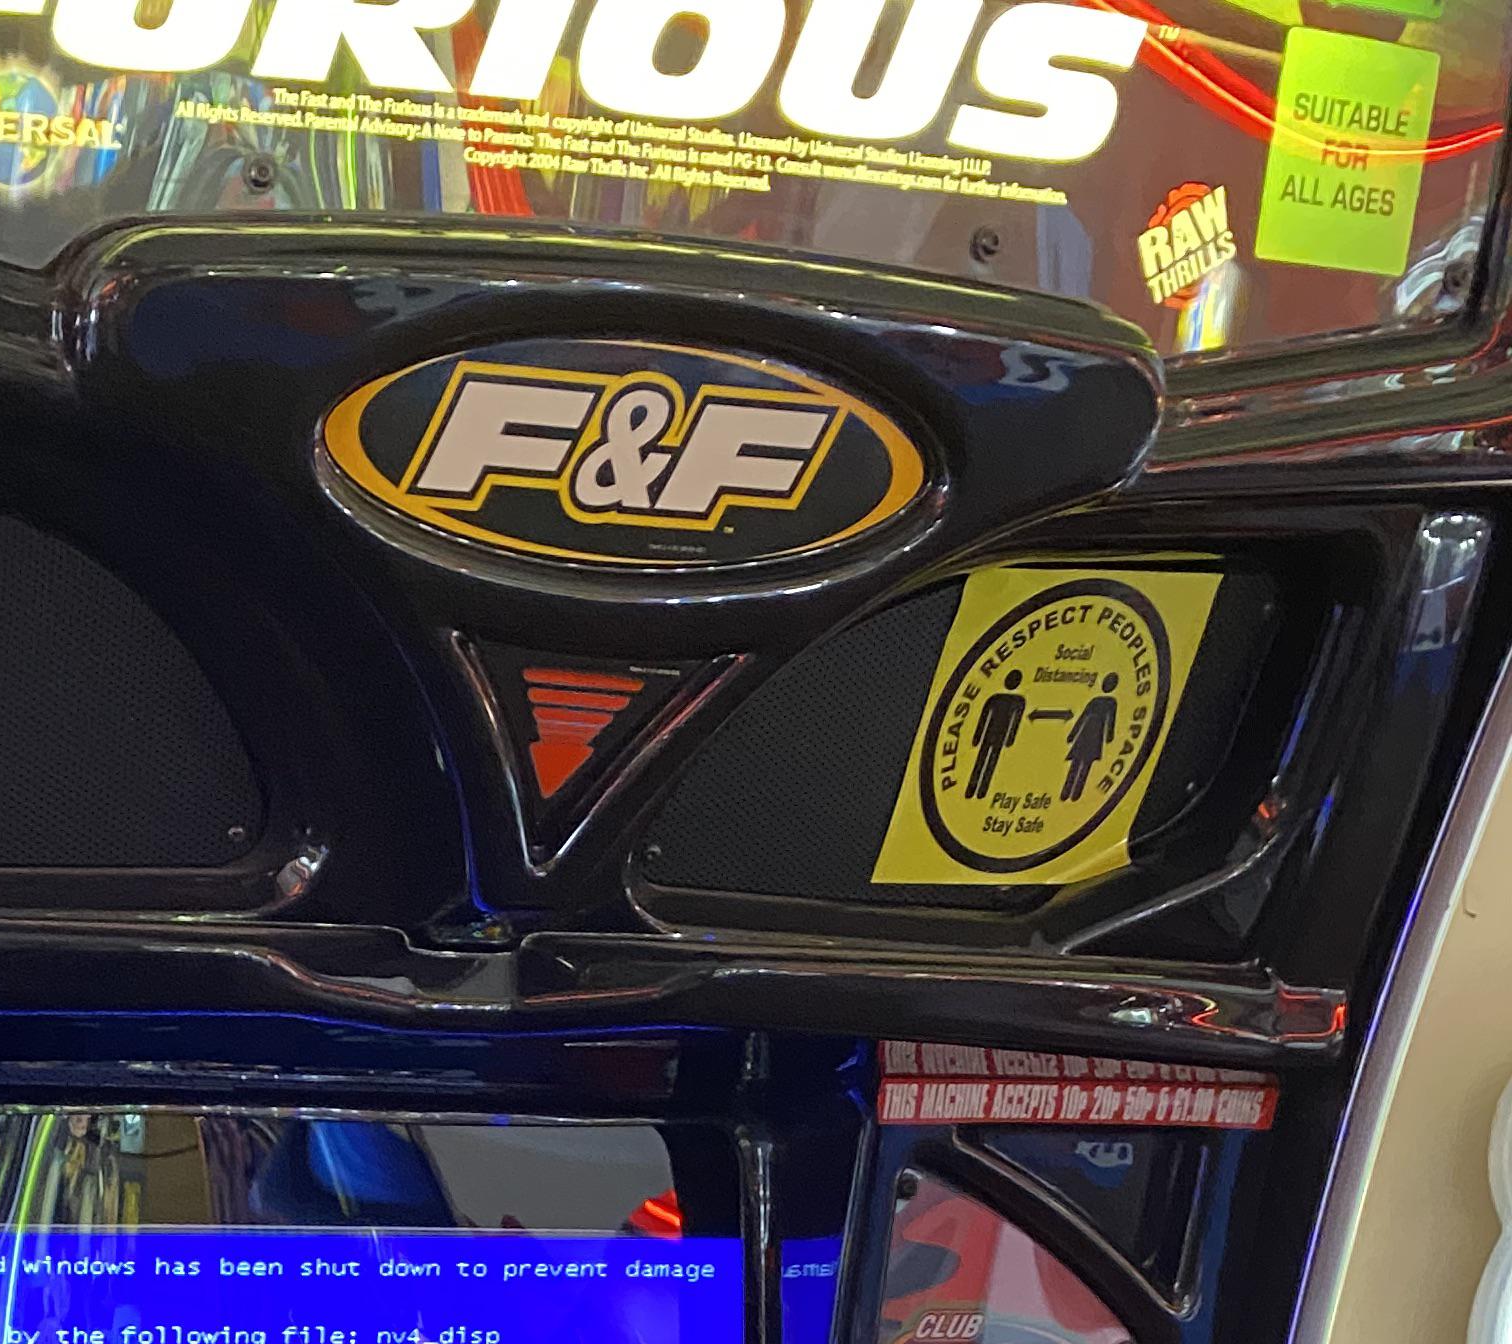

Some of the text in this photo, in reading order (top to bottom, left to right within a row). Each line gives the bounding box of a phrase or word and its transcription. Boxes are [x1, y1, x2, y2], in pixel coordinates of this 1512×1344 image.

[1293, 92, 1411, 137] SUITABLE
[1321, 139, 1370, 172] FOR
[1280, 175, 1396, 217] ALL AGES
[1138, 185, 1230, 279] RAW
[1147, 231, 1237, 304] THRILLS
[413, 378, 834, 516] F&F
[1054, 644, 1095, 662] Social
[1033, 666, 1100, 690] Distancing
[941, 604, 1151, 795] PLEASE RESPECT PEOPLES SPACE
[990, 793, 1053, 812] Play Safe
[983, 817, 1045, 836] Stay Safe
[920, 1083, 989, 1120] MACHINE
[990, 1084, 1059, 1120] ACCEPTS
[22, 1256, 136, 1276] windows
[155, 1257, 201, 1276] has
[219, 1257, 283, 1276] been
[300, 1258, 360, 1277] shut
[378, 1258, 441, 1277] down
[457, 1261, 488, 1278] to
[503, 1261, 608, 1281] prevent
[625, 1260, 716, 1282] damage
[55, 1326, 105, 1344] the
[283, 1326, 358, 1344] file:
[915, 1312, 984, 1339] CLUB
